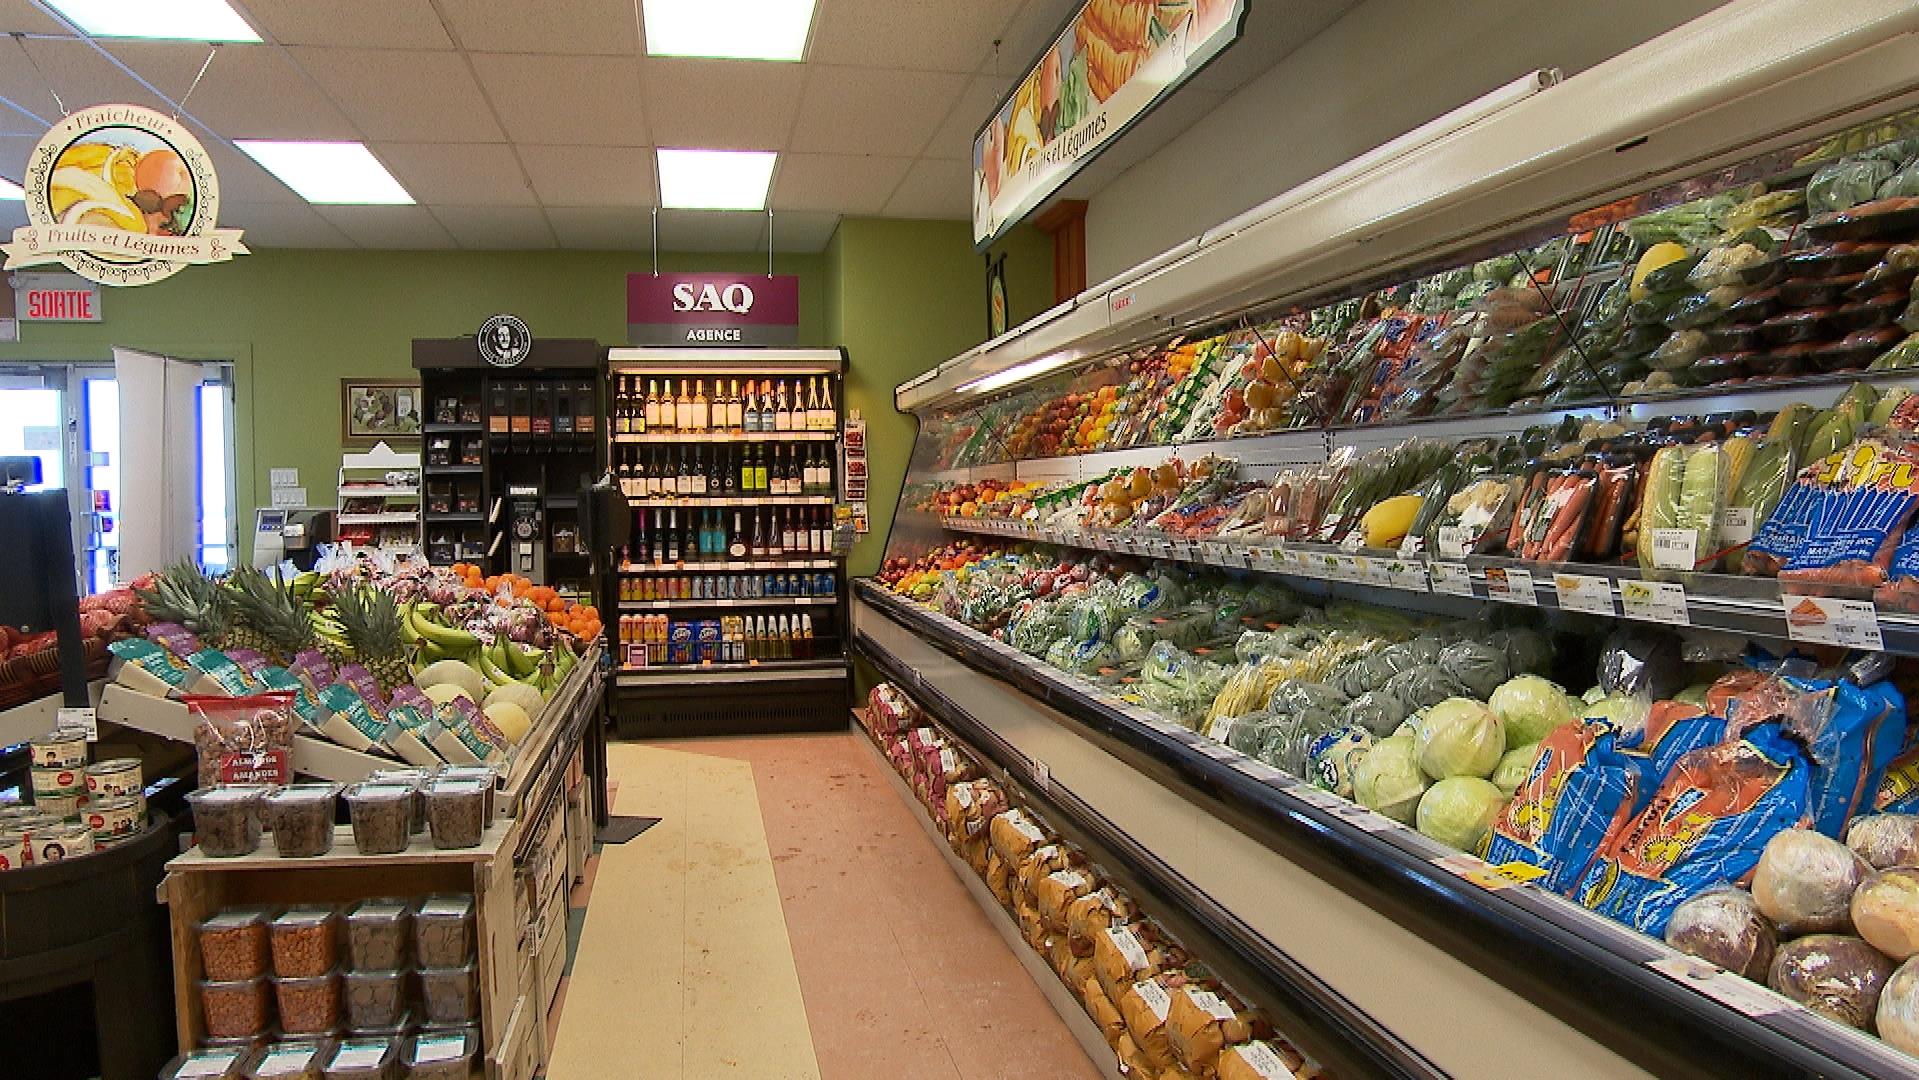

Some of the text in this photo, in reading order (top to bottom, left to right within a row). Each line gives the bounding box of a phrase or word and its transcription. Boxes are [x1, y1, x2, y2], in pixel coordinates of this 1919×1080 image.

[1062, 111, 1107, 158] Légumes
[47, 229, 200, 256] Fruits et Légumes
[28, 290, 93, 320] SORTIE
[672, 282, 754, 314] SAQ
[686, 329, 741, 341] AGENCE
